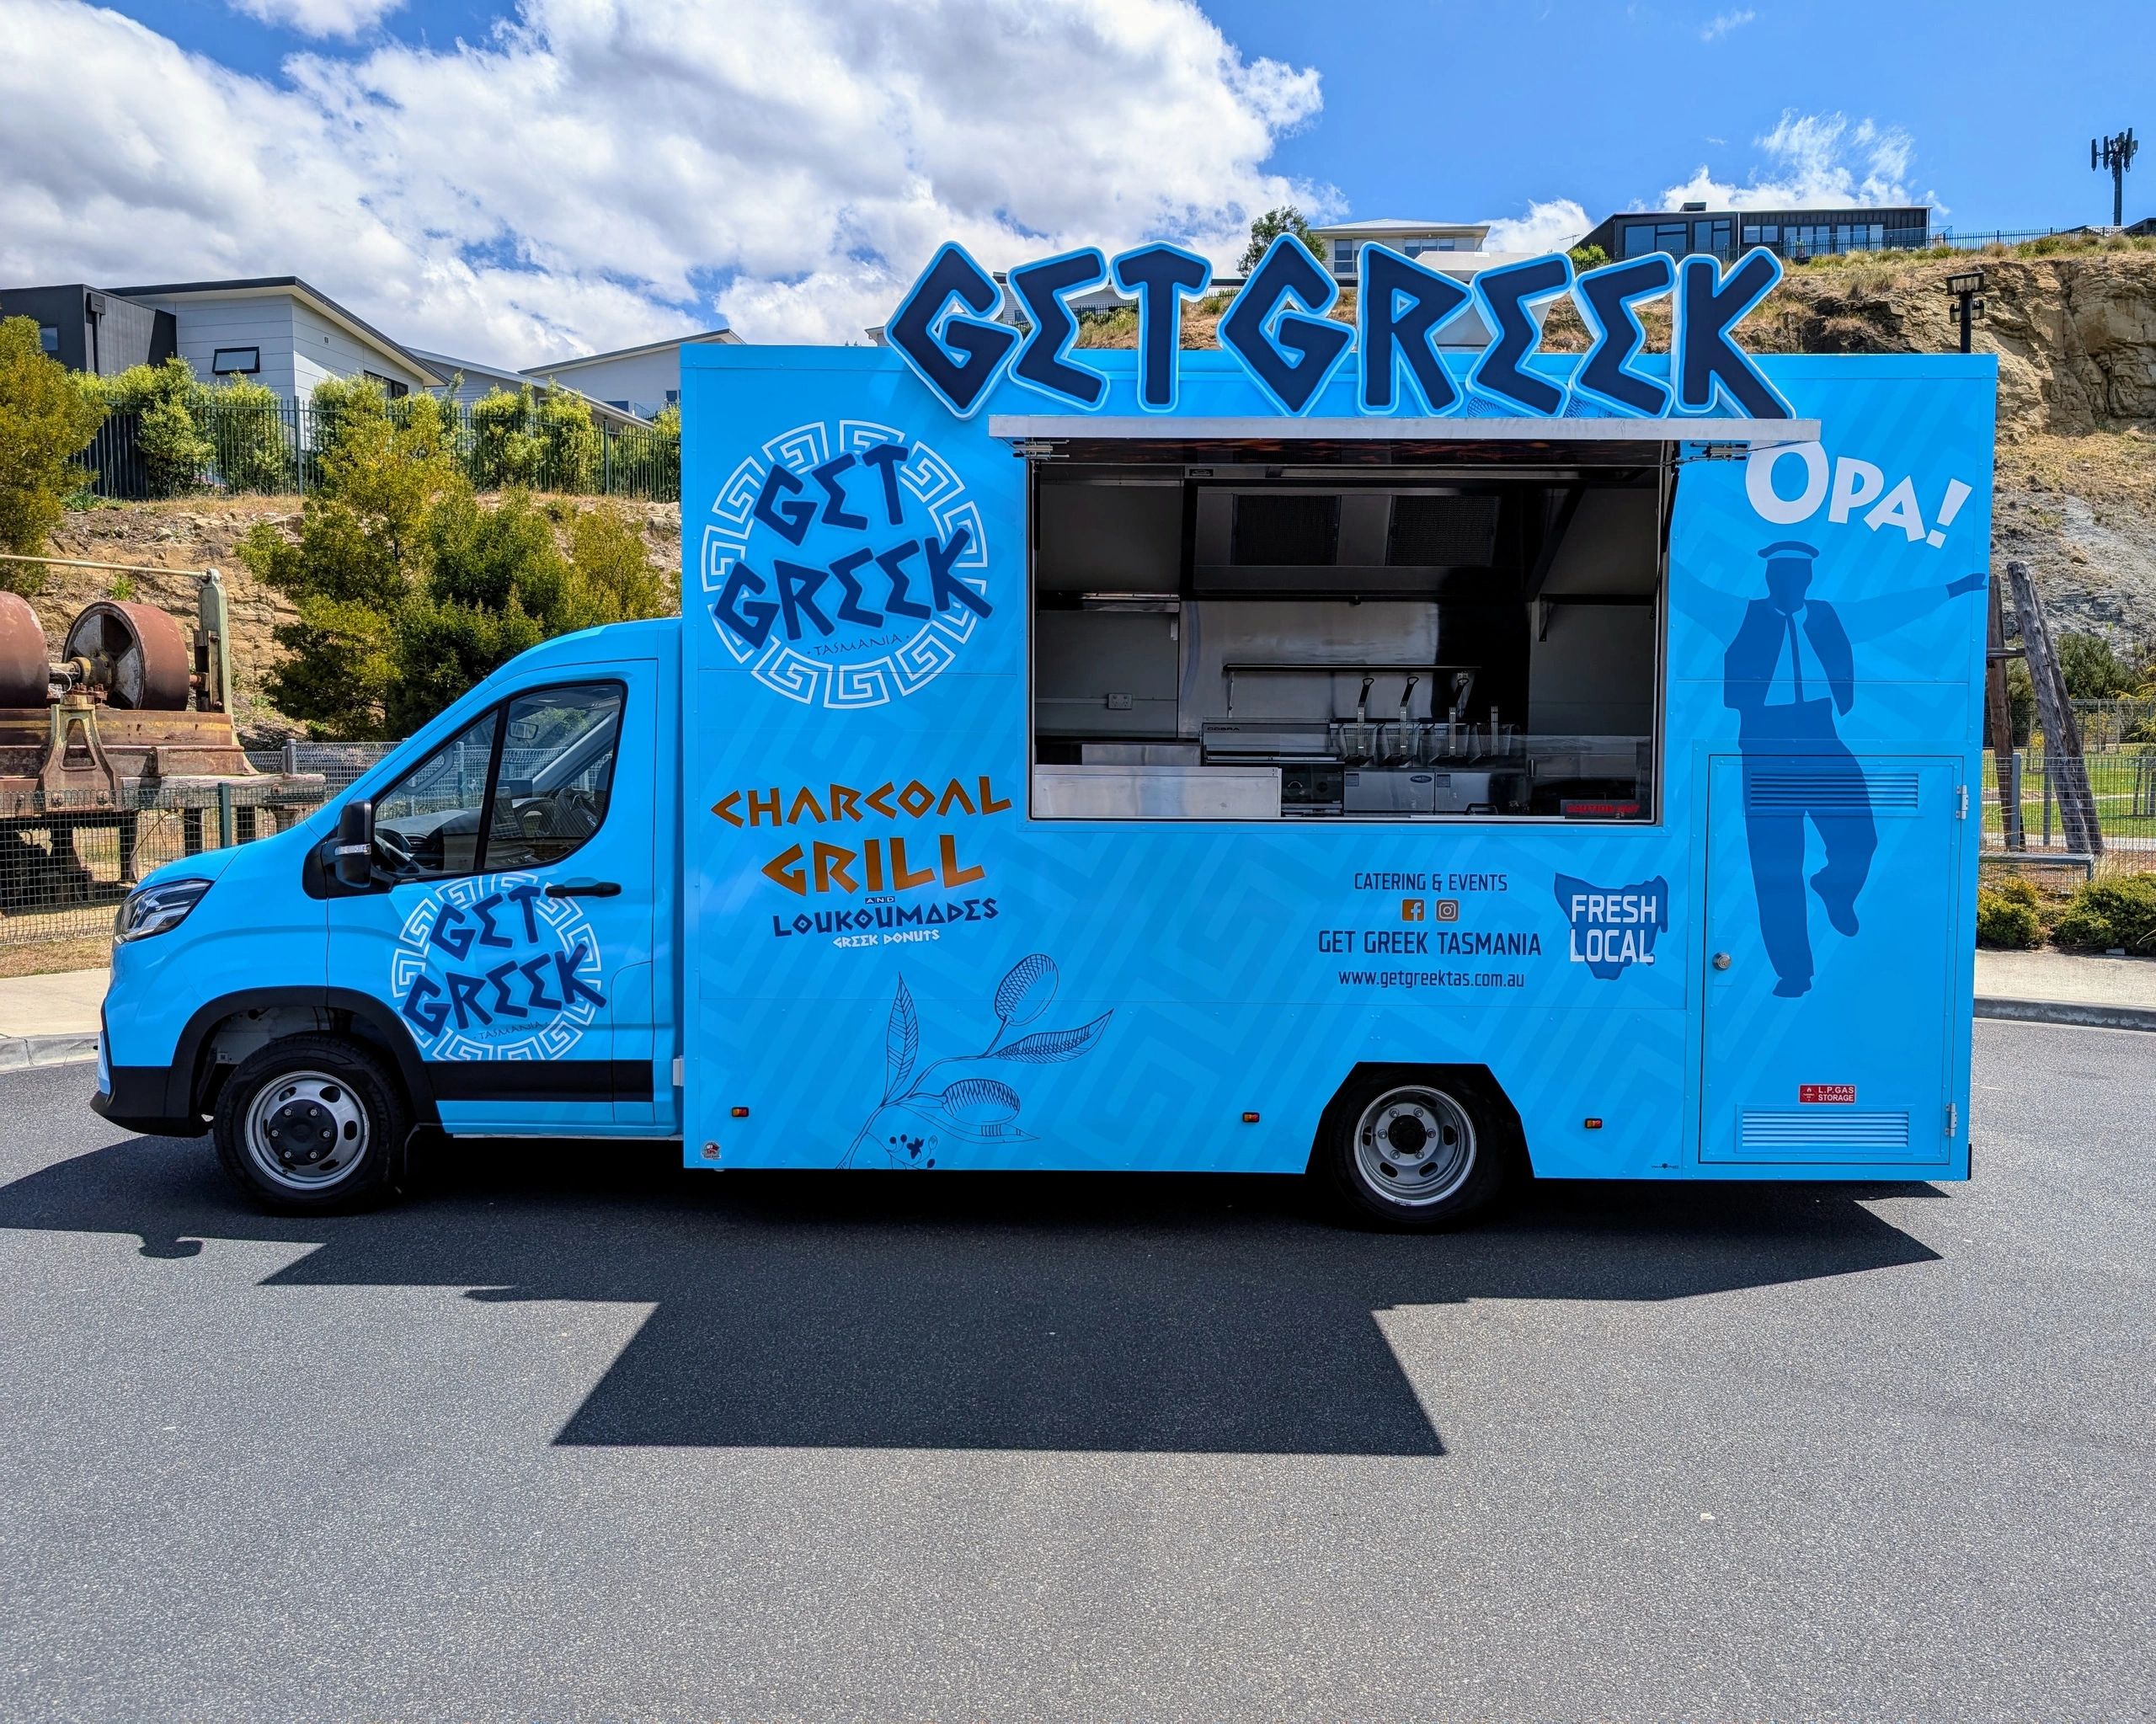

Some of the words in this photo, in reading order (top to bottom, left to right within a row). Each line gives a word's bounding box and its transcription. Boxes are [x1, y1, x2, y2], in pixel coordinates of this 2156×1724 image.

[883, 240, 1213, 419] GET
[1217, 232, 1796, 419] GREEK
[753, 443, 909, 547] GET
[1745, 440, 1973, 549] OPA!
[713, 527, 994, 649] GREEK
[814, 633, 903, 655] TASMANIA
[711, 776, 1011, 828] CHARCOAL
[761, 834, 985, 896] GRILL
[1354, 873, 1427, 891] CATERING
[1432, 873, 1442, 893] &
[1448, 873, 1508, 892] EVENTS
[429, 885, 542, 962] GET
[772, 897, 1000, 937] LOUKOUMADES
[1572, 894, 1657, 924] FRESH
[832, 933, 878, 949] GREEK
[883, 929, 941, 945] DONUTS
[1318, 930, 1356, 953] GET
[1364, 931, 1429, 954] GREEK
[1437, 931, 1542, 957] TASMANIA
[1569, 928, 1655, 963] LOCAL
[402, 942, 607, 1038] GREEK
[1338, 970, 1525, 989] www.getgreektas.com.au
